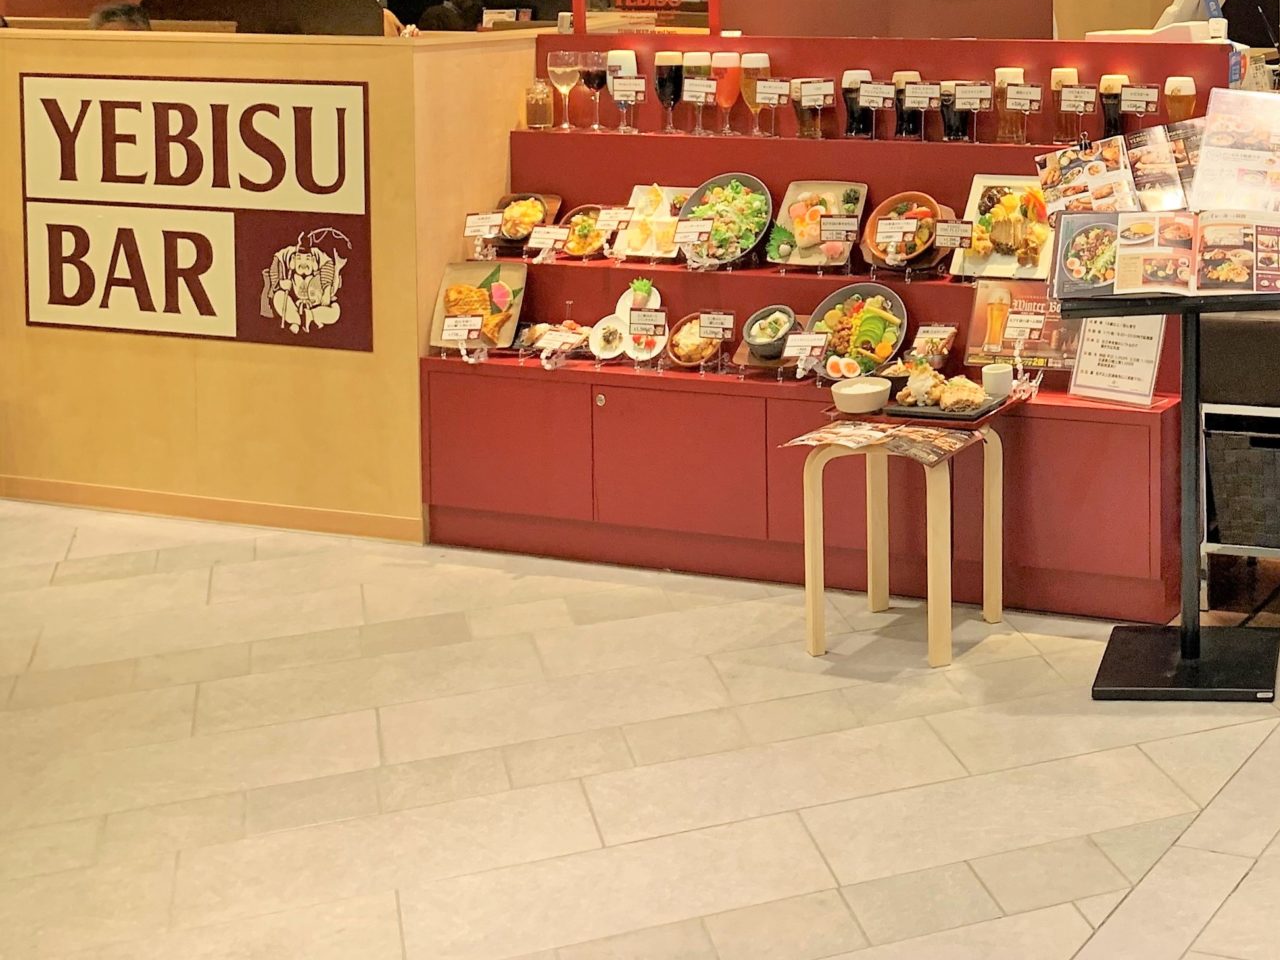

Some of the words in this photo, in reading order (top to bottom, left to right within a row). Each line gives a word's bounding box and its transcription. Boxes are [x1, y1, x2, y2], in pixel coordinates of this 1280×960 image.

[39, 98, 347, 195] YEBISU
[45, 223, 218, 317] BAR
[1012, 299, 1047, 312] Winter
